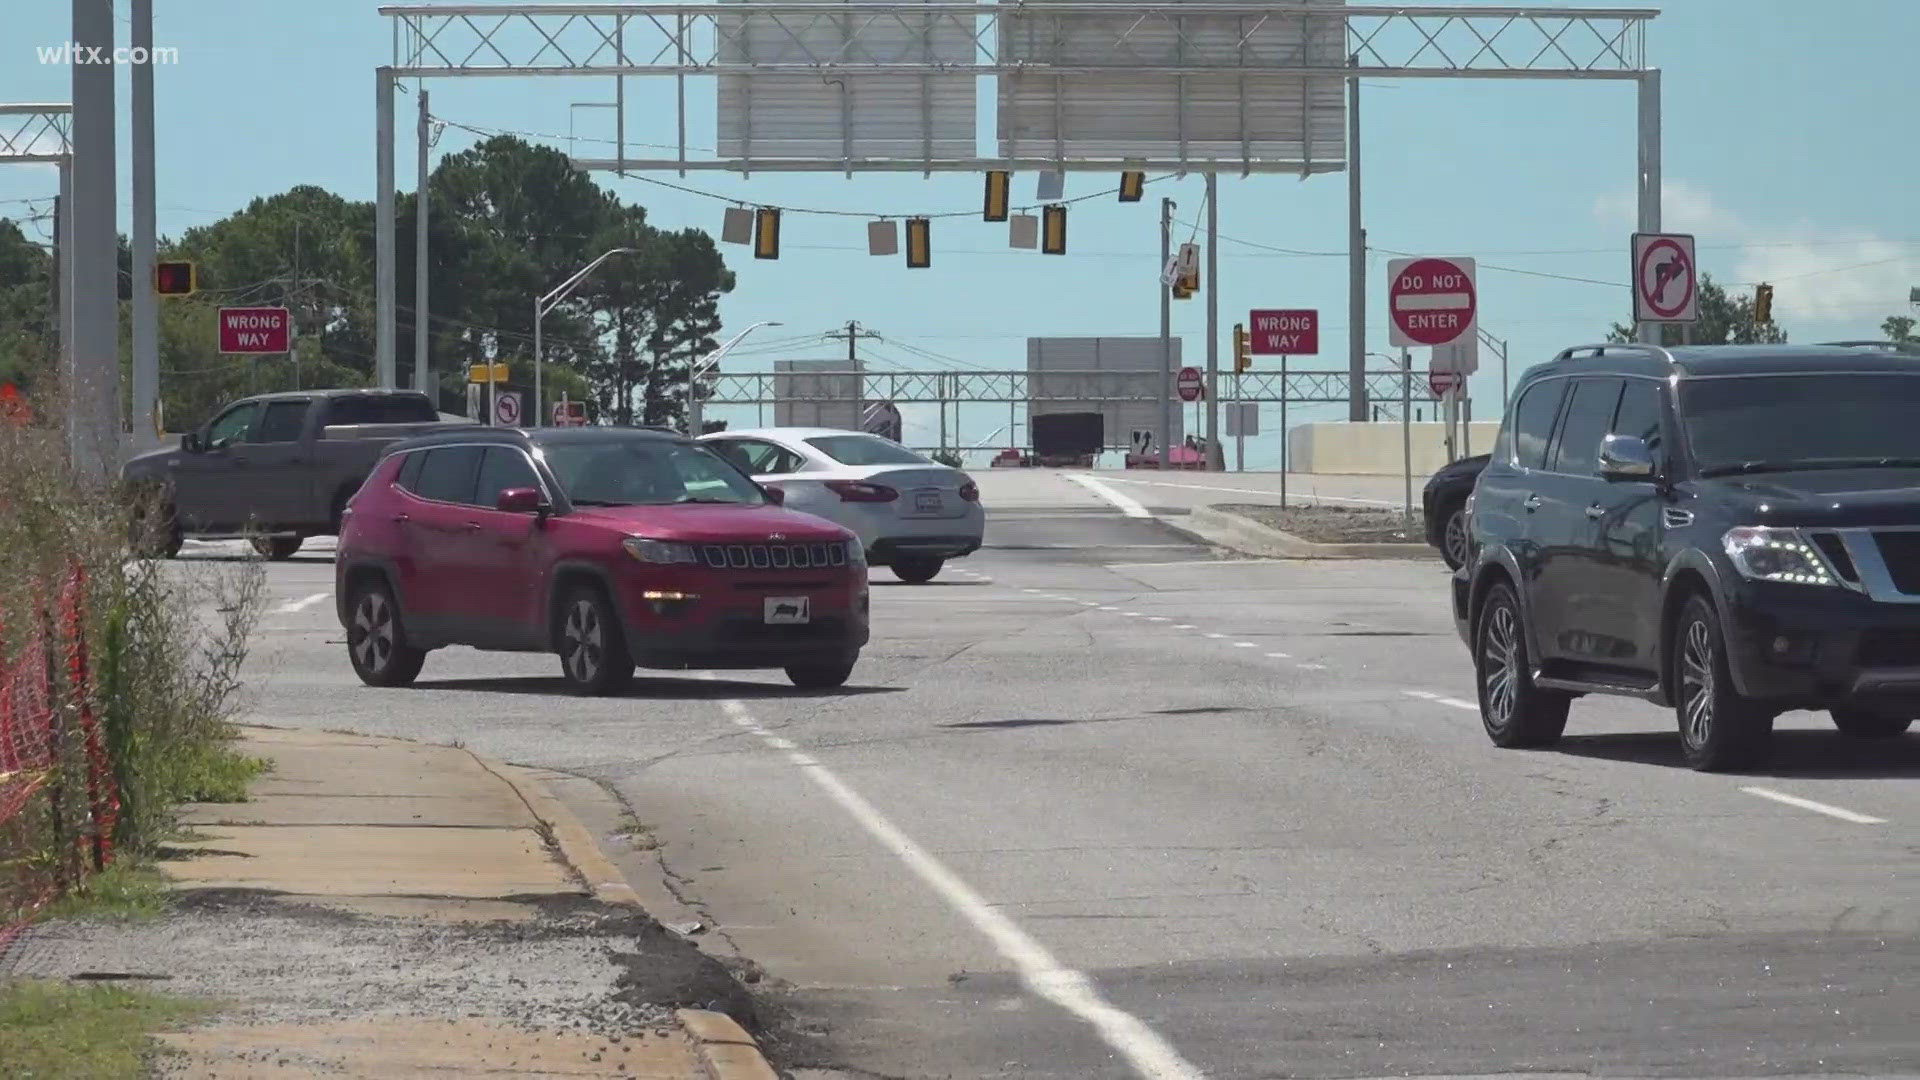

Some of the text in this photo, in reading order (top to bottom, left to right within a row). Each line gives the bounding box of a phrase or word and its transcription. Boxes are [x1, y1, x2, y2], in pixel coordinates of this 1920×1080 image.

[1402, 275, 1462, 290] DO NOT
[227, 315, 281, 329] WRONG
[1257, 316, 1311, 331] WRONG
[1408, 314, 1458, 329] ENTER
[238, 333, 269, 346] WAY
[1268, 335, 1300, 348] WAY
